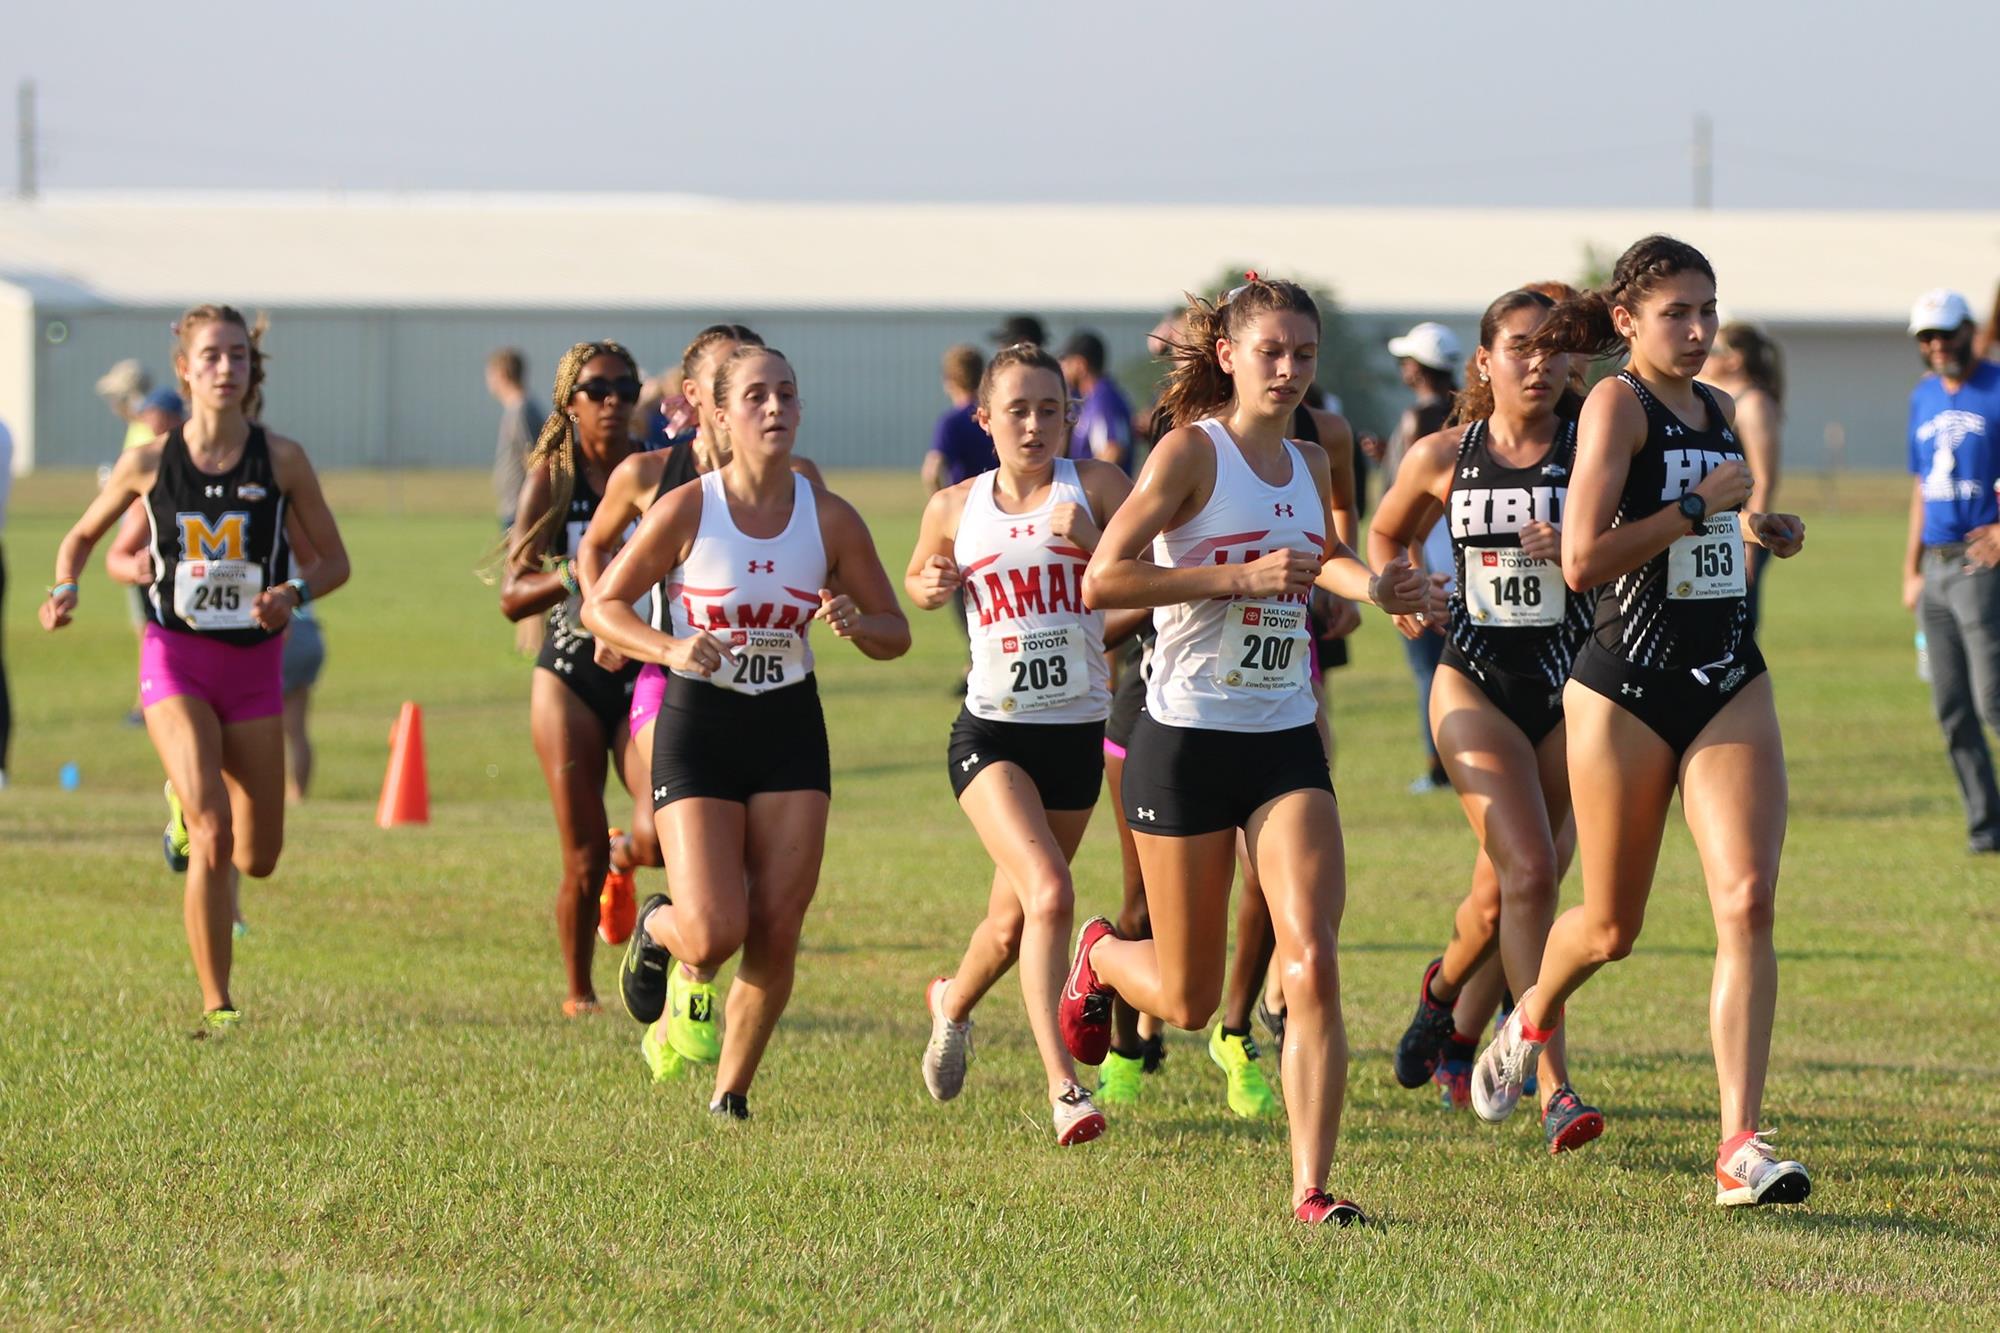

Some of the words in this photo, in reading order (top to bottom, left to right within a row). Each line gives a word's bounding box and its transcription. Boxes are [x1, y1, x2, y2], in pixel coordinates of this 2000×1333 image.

[1451, 486, 1568, 539] HBU
[176, 511, 250, 561] M
[1707, 523, 1734, 535] OYOTA
[1501, 558, 1547, 568] TOYOTA
[1691, 542, 1733, 578] 153
[194, 585, 240, 611] 245
[1490, 575, 1541, 607] 148
[1262, 616, 1298, 630] TOYOTA
[750, 637, 791, 649] TOYOTA
[1021, 636, 1068, 652] TOYOTA
[1240, 634, 1296, 671] 200
[733, 654, 785, 685] 205
[1010, 655, 1068, 693] 203
